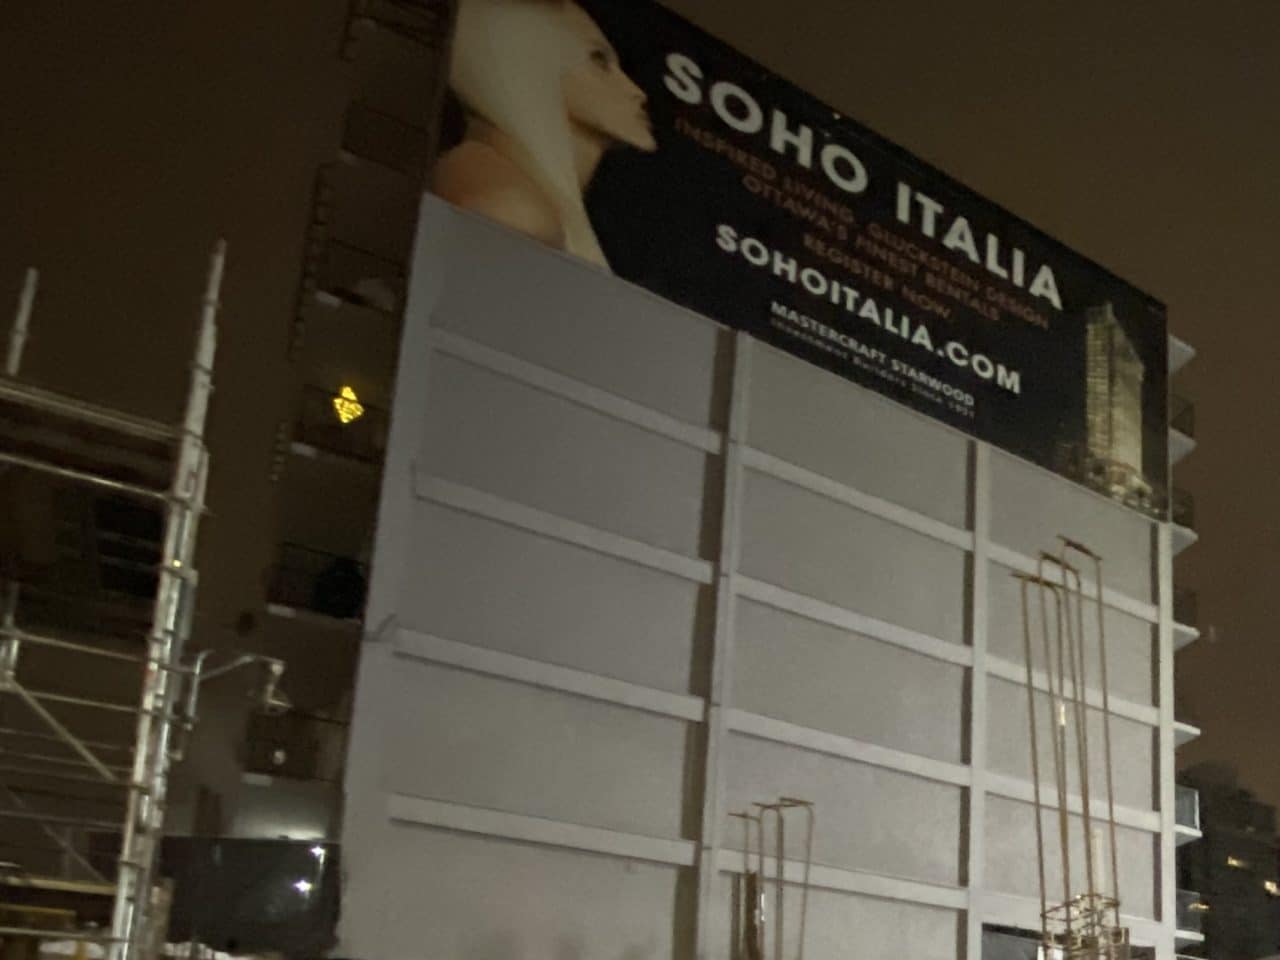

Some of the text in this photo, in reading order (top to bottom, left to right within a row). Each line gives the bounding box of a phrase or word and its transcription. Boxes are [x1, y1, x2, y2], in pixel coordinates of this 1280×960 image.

[664, 52, 1063, 311] SOHO ITALIA
[715, 223, 1021, 394] SOHOITALIA.COM
[770, 301, 886, 364] MASTERCRAFT
[890, 357, 975, 407] STARWOOD
[903, 284, 951, 318] NOW
